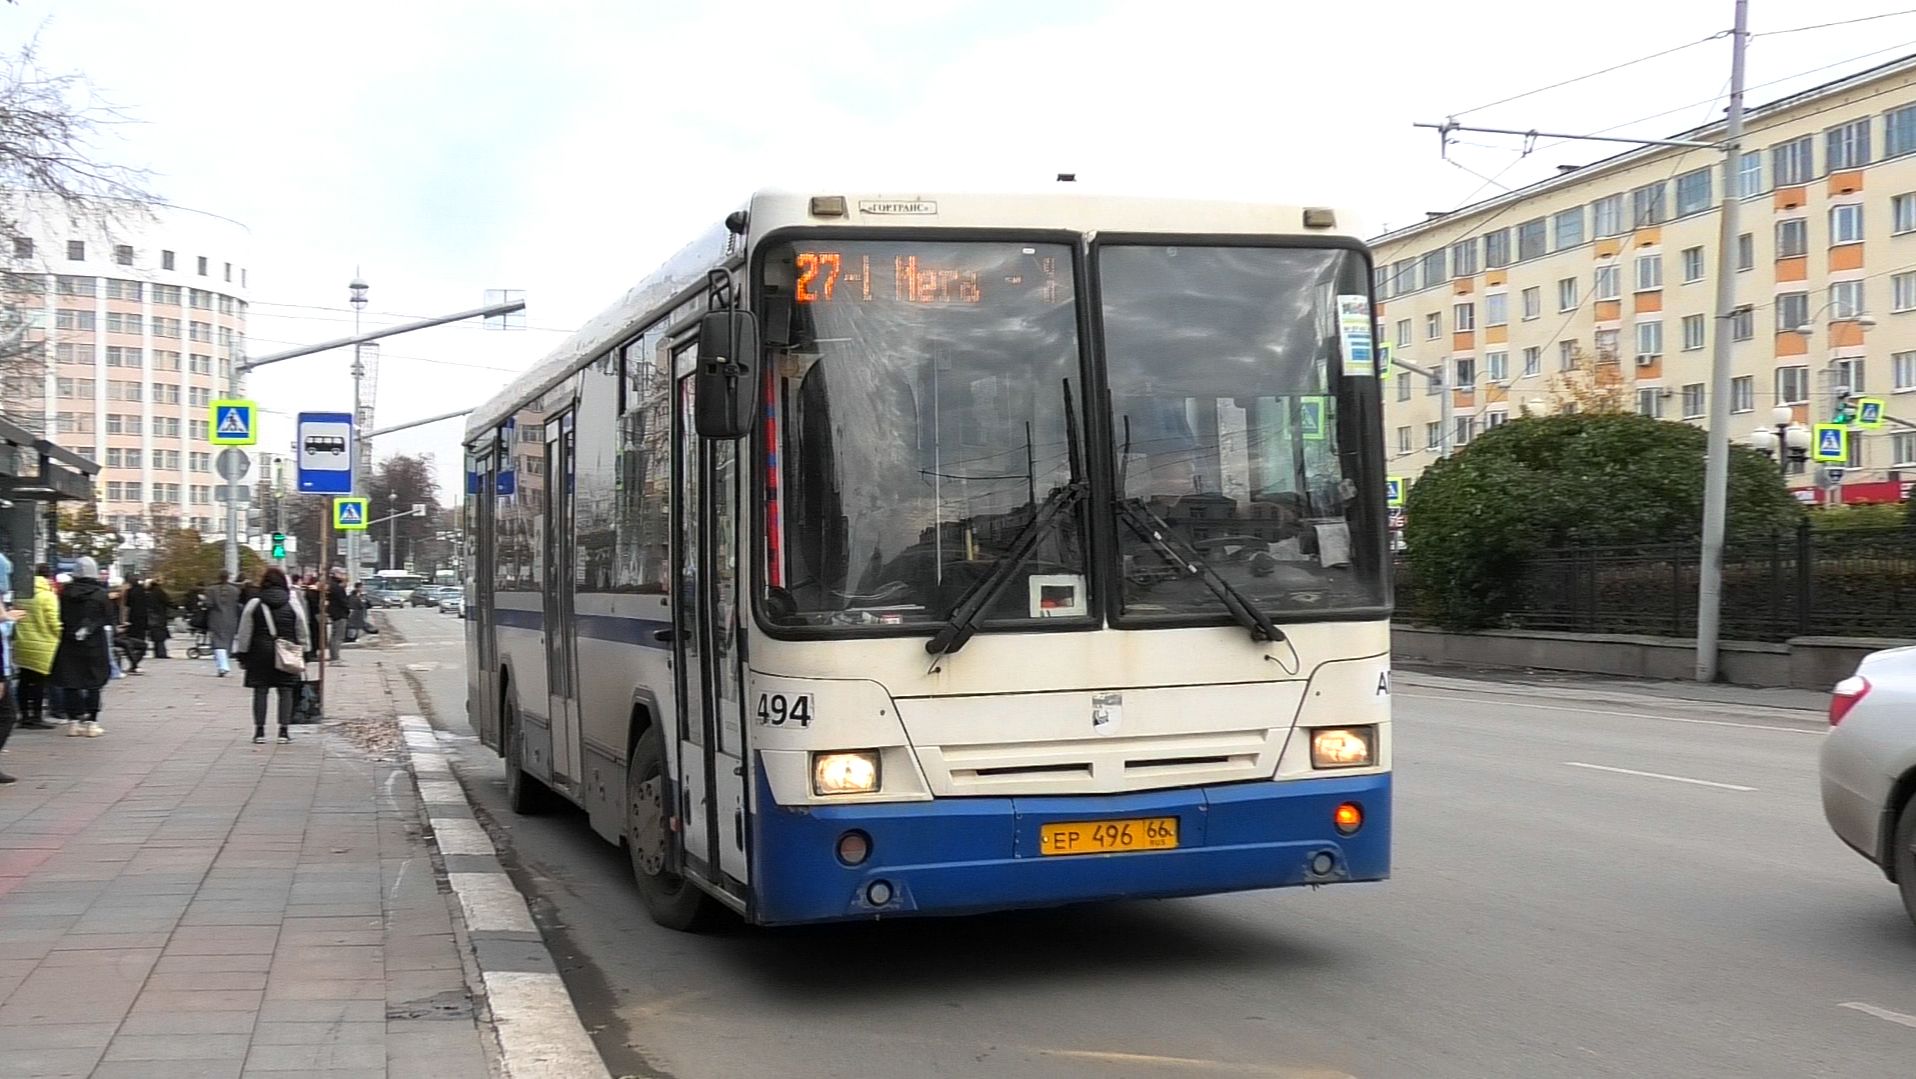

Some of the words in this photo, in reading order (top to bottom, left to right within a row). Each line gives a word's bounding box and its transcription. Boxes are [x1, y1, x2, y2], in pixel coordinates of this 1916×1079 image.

[757, 693, 812, 727] 494
[1053, 831, 1081, 850] ЕР
[1092, 823, 1134, 848] 496
[1146, 821, 1170, 838] 66
